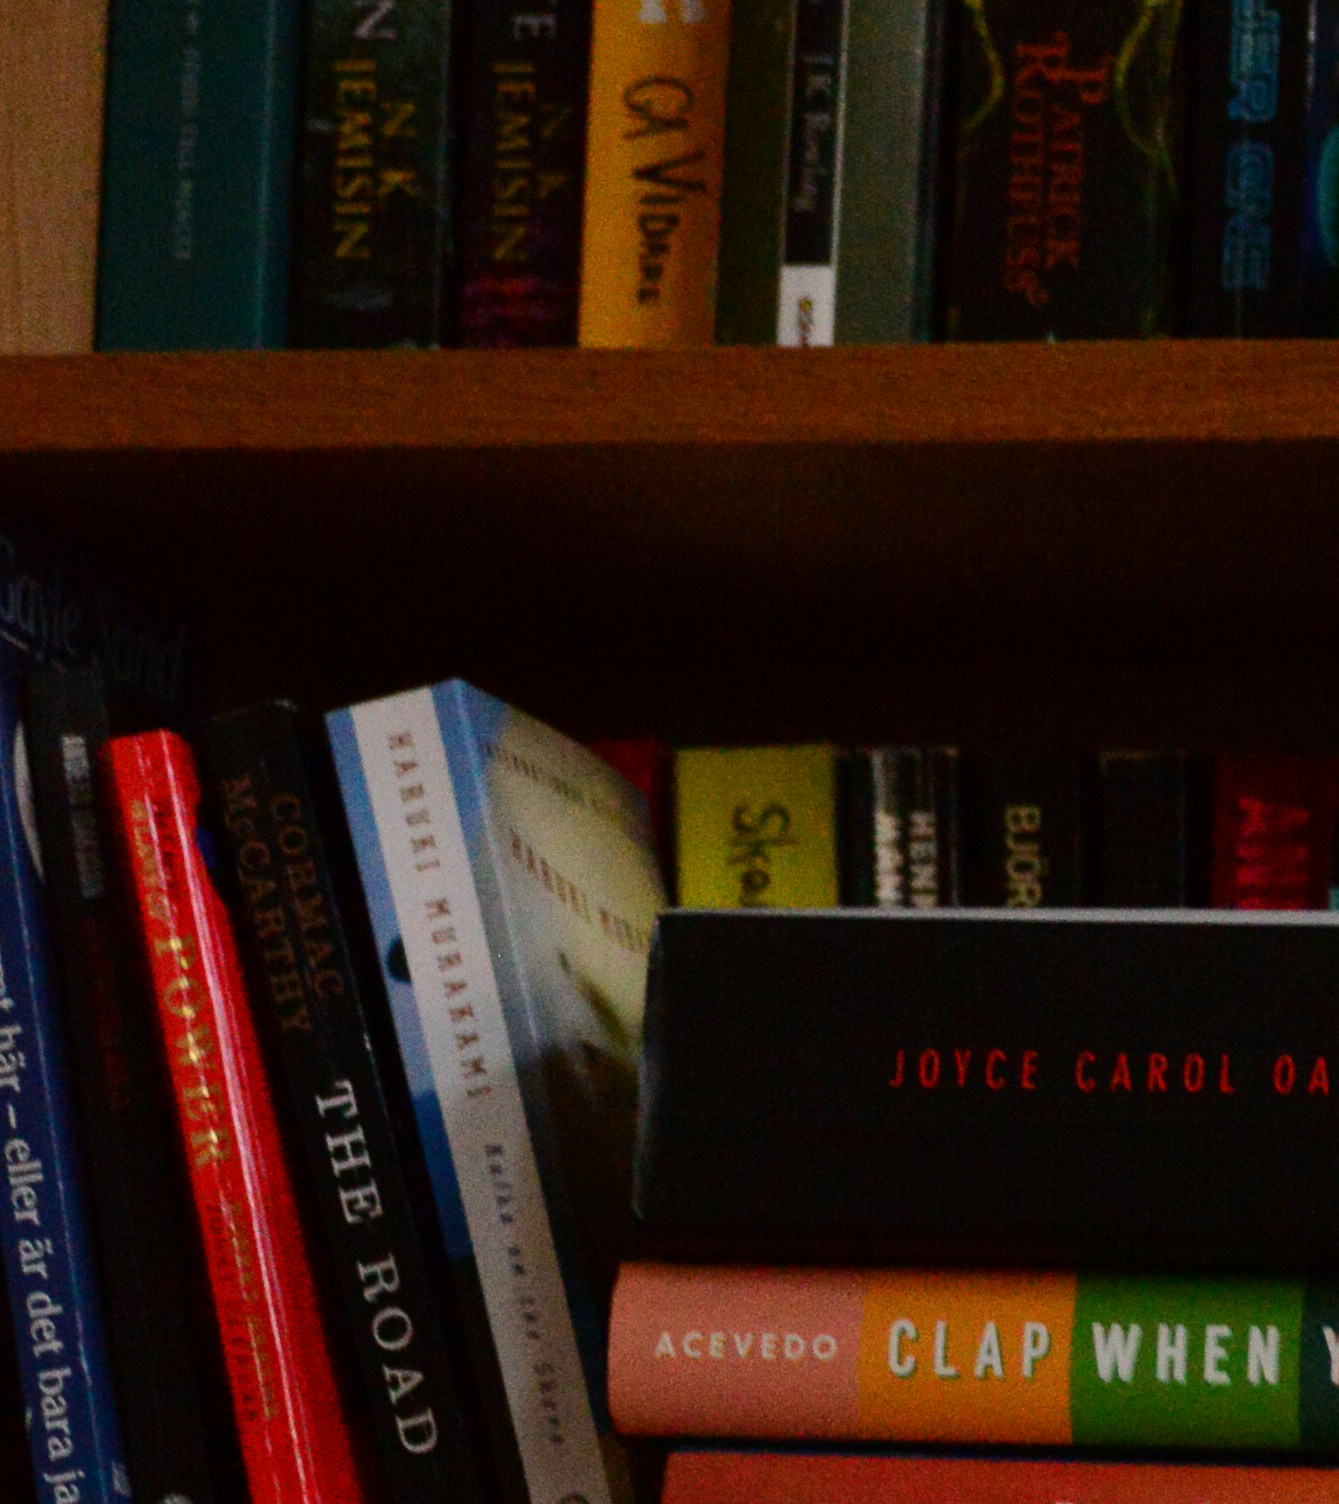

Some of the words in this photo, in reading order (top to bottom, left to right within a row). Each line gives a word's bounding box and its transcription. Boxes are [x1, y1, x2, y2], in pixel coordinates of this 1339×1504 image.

[331, 58, 381, 259] JEMISIN
[488, 60, 537, 262] JEMISIN
[1042, 68, 1119, 268] PATRICK
[219, 773, 312, 1037] McCARTHY
[270, 791, 345, 999] CORMAC
[385, 731, 443, 875] HARUKI
[423, 897, 495, 1101] MURAKAMI
[483, 1144, 518, 1228] Kafka
[152, 933, 236, 1173] POWER
[888, 1050, 1039, 1089] JOYCE
[1073, 1051, 1235, 1094] CAROL
[2, 1137, 45, 1225] eller
[17, 1237, 55, 1280] är
[311, 1078, 385, 1226] THE
[355, 1251, 440, 1457] ROAD
[24, 1290, 70, 1359] det
[36, 1367, 82, 1461] bara
[654, 1330, 840, 1362] ACEVEDO
[888, 1318, 1051, 1380] CLAP
[1092, 1322, 1281, 1388] WHEN
